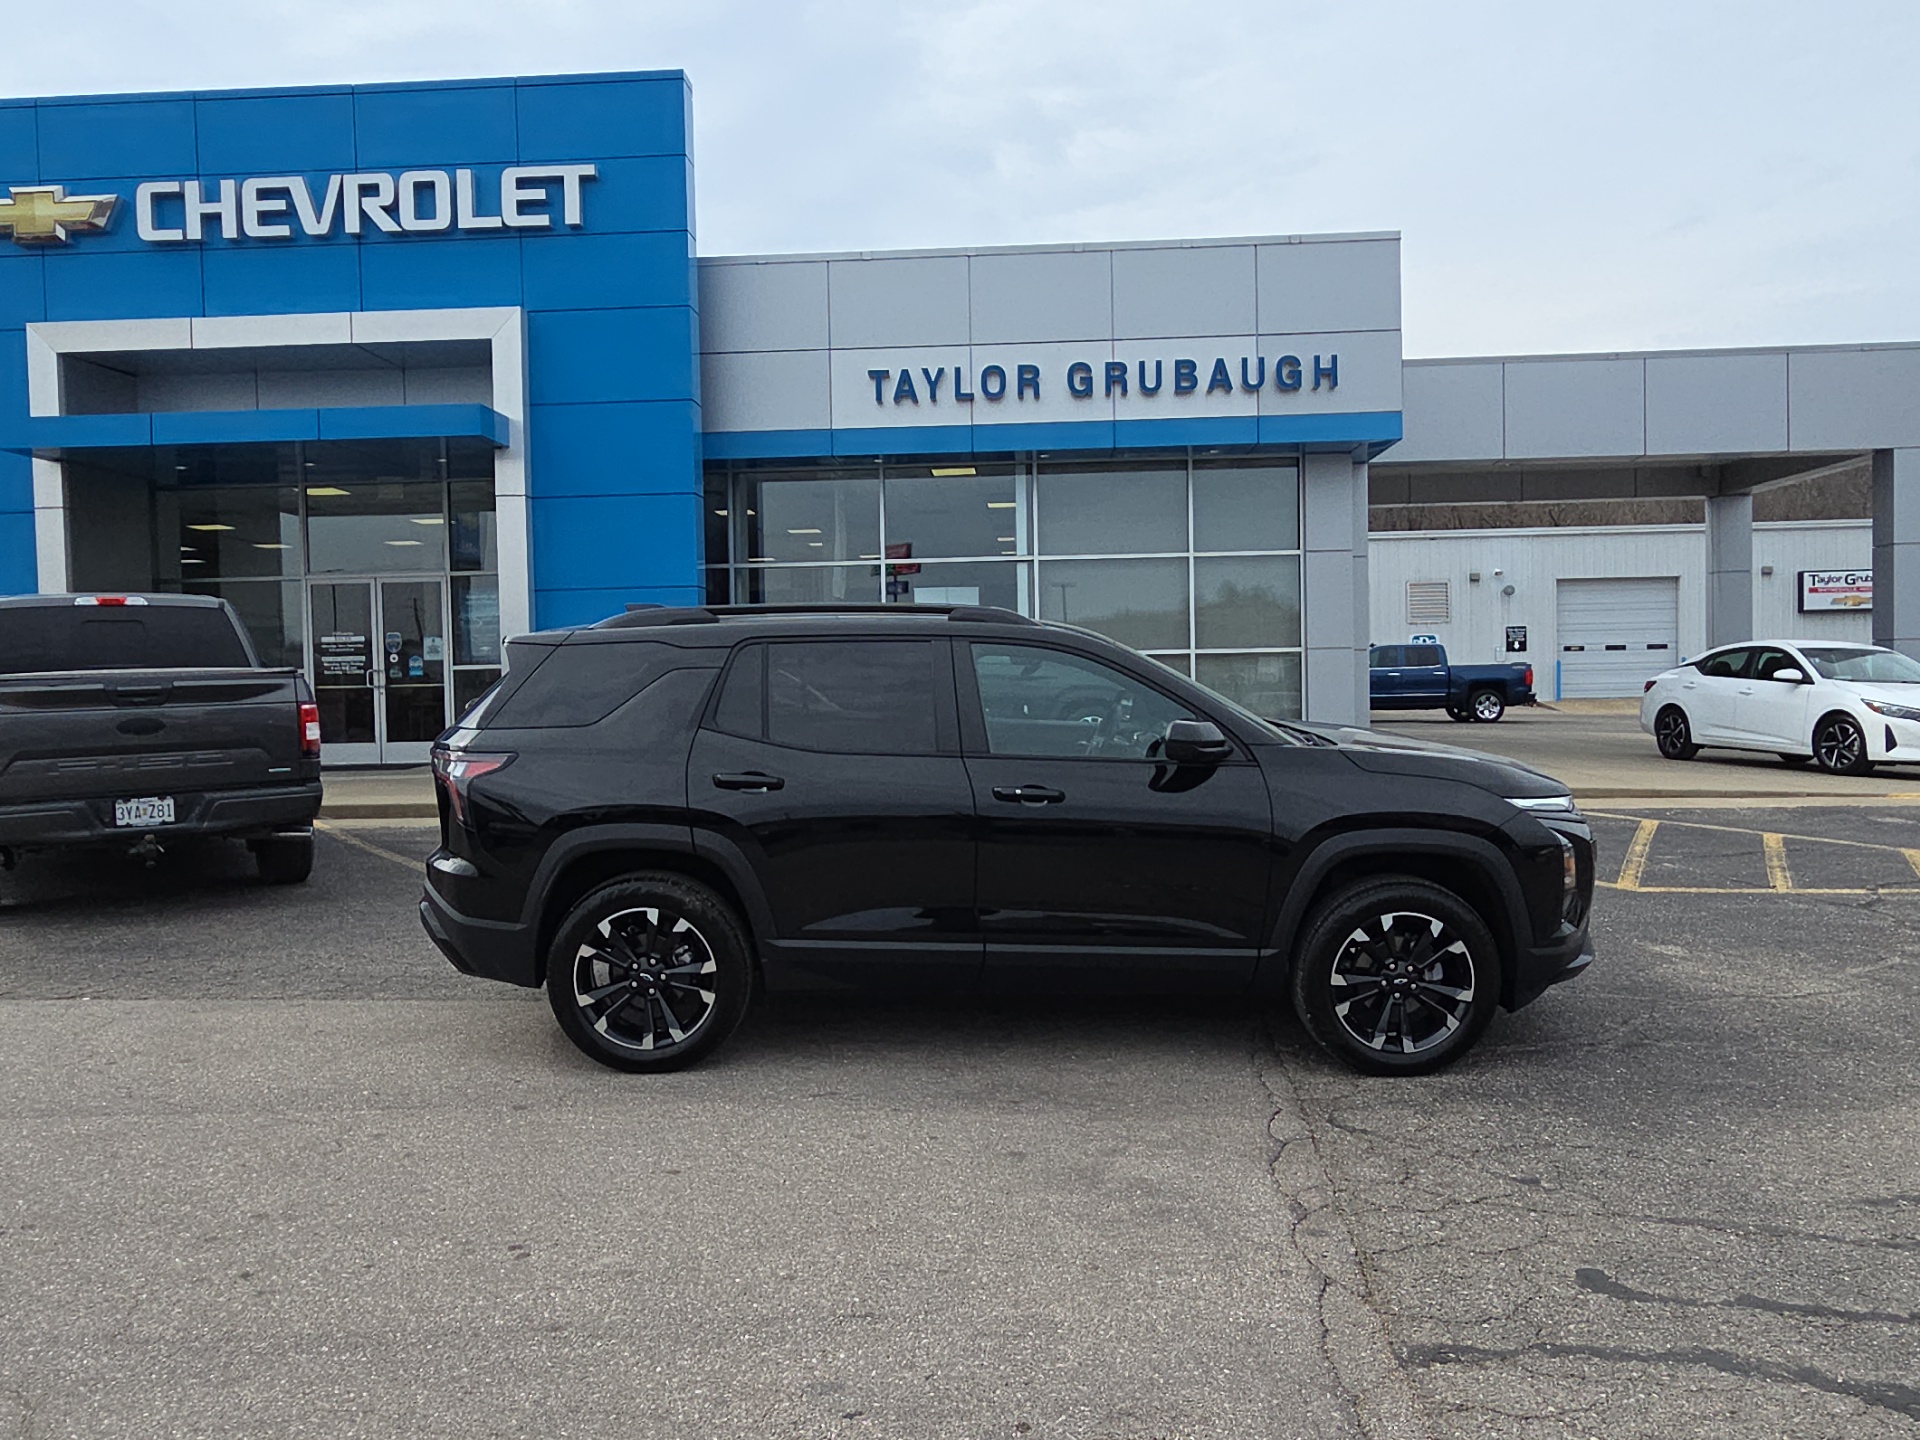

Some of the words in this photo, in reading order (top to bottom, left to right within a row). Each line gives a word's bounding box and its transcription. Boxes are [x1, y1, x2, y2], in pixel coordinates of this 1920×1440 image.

[136, 164, 597, 242] CHEVROLET
[867, 363, 1040, 404] TAYLOR
[1066, 354, 1340, 399] GRUBAUGH
[1808, 574, 1843, 586] Taylor
[117, 805, 142, 820] 3YA
[148, 803, 172, 819] Z81
